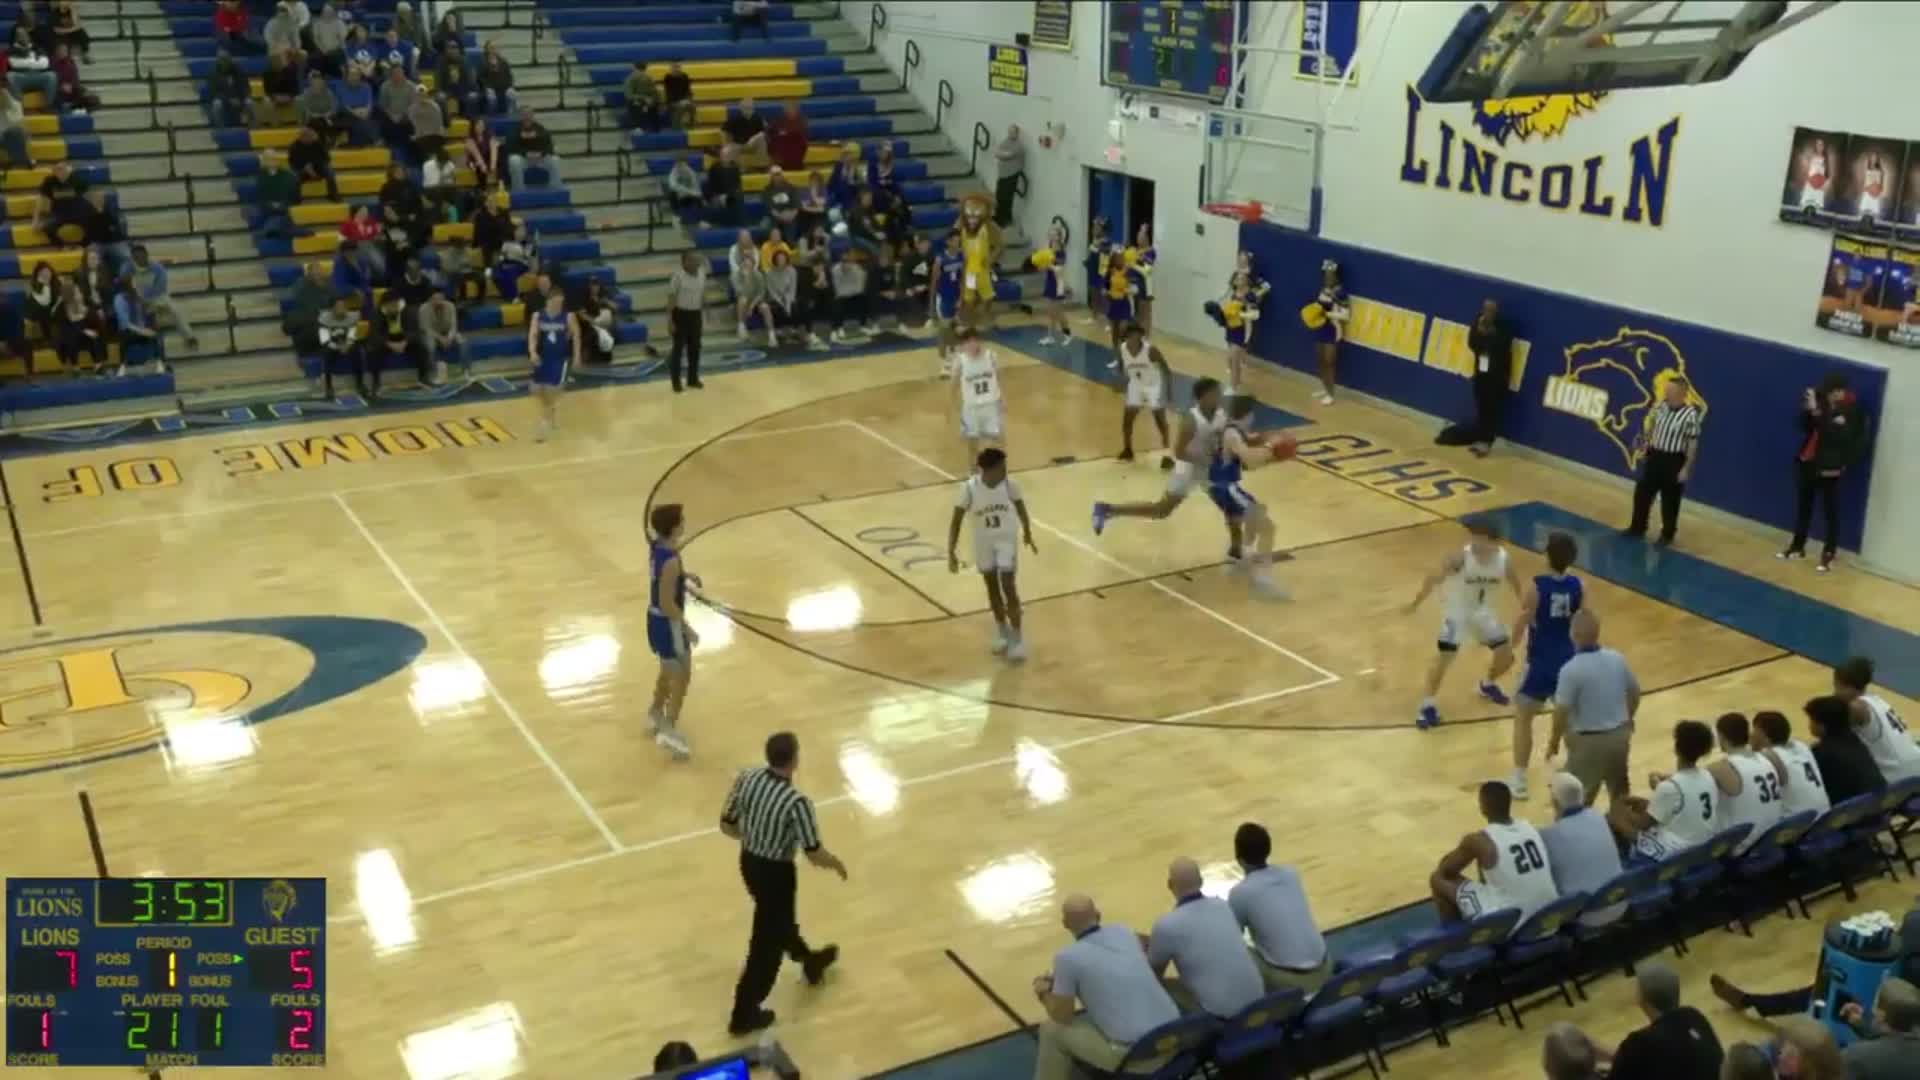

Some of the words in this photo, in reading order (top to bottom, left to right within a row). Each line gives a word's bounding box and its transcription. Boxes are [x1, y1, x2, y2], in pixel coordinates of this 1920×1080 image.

[1400, 83, 1680, 228] LINCOLN
[1543, 376, 1609, 421] LIONS
[214, 415, 517, 478] HOME
[1294, 434, 1492, 501] GLHS
[42, 455, 183, 504] OF
[1700, 791, 1712, 820] 3
[1754, 772, 1780, 803] 32
[1510, 839, 1545, 875] 20
